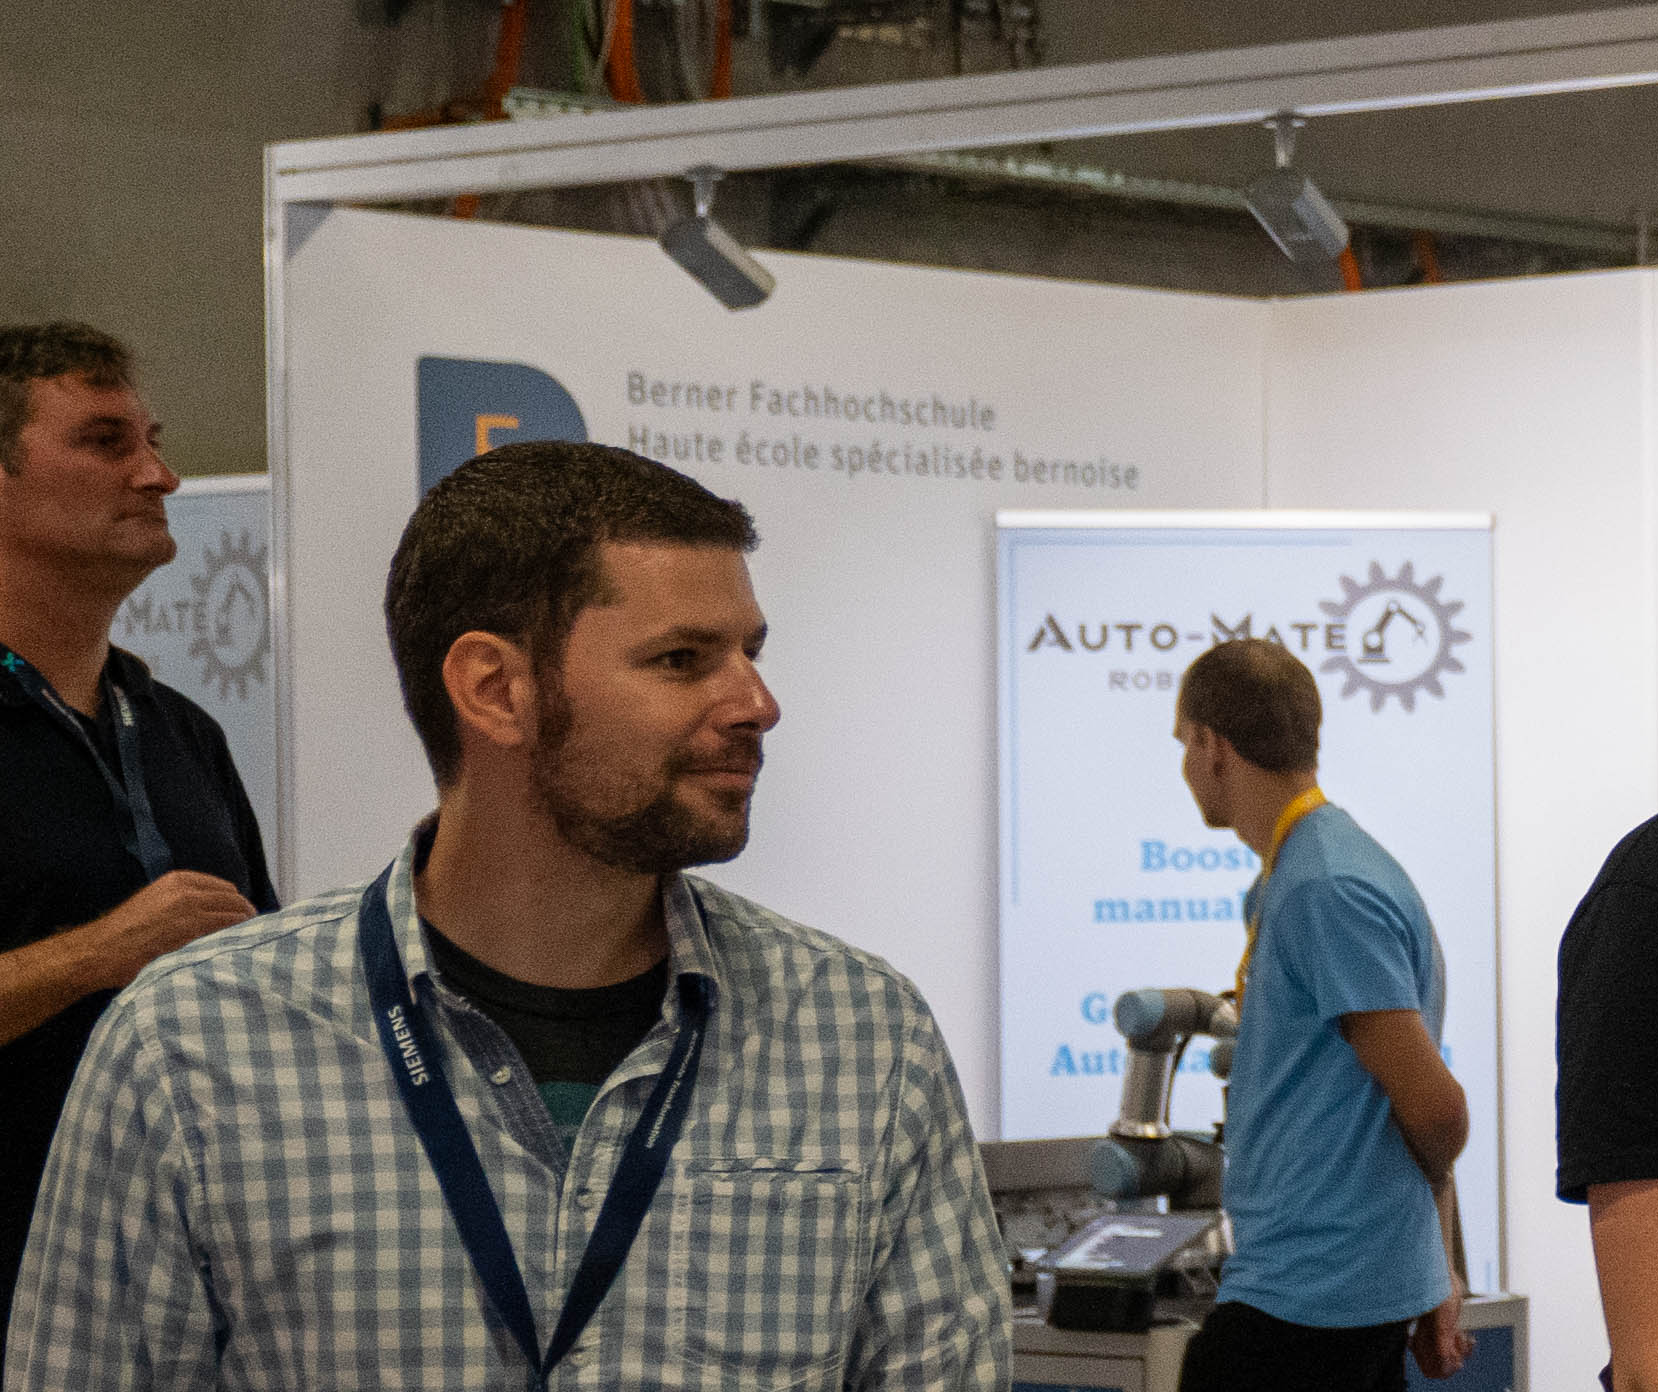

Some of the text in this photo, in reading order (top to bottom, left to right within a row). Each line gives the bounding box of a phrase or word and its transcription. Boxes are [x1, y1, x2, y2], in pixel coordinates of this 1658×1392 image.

[627, 369, 997, 431] Berner Fachhochschule
[627, 424, 1140, 492] Haute école spécialisée bernoise
[388, 1004, 430, 1087] SIEMENS
